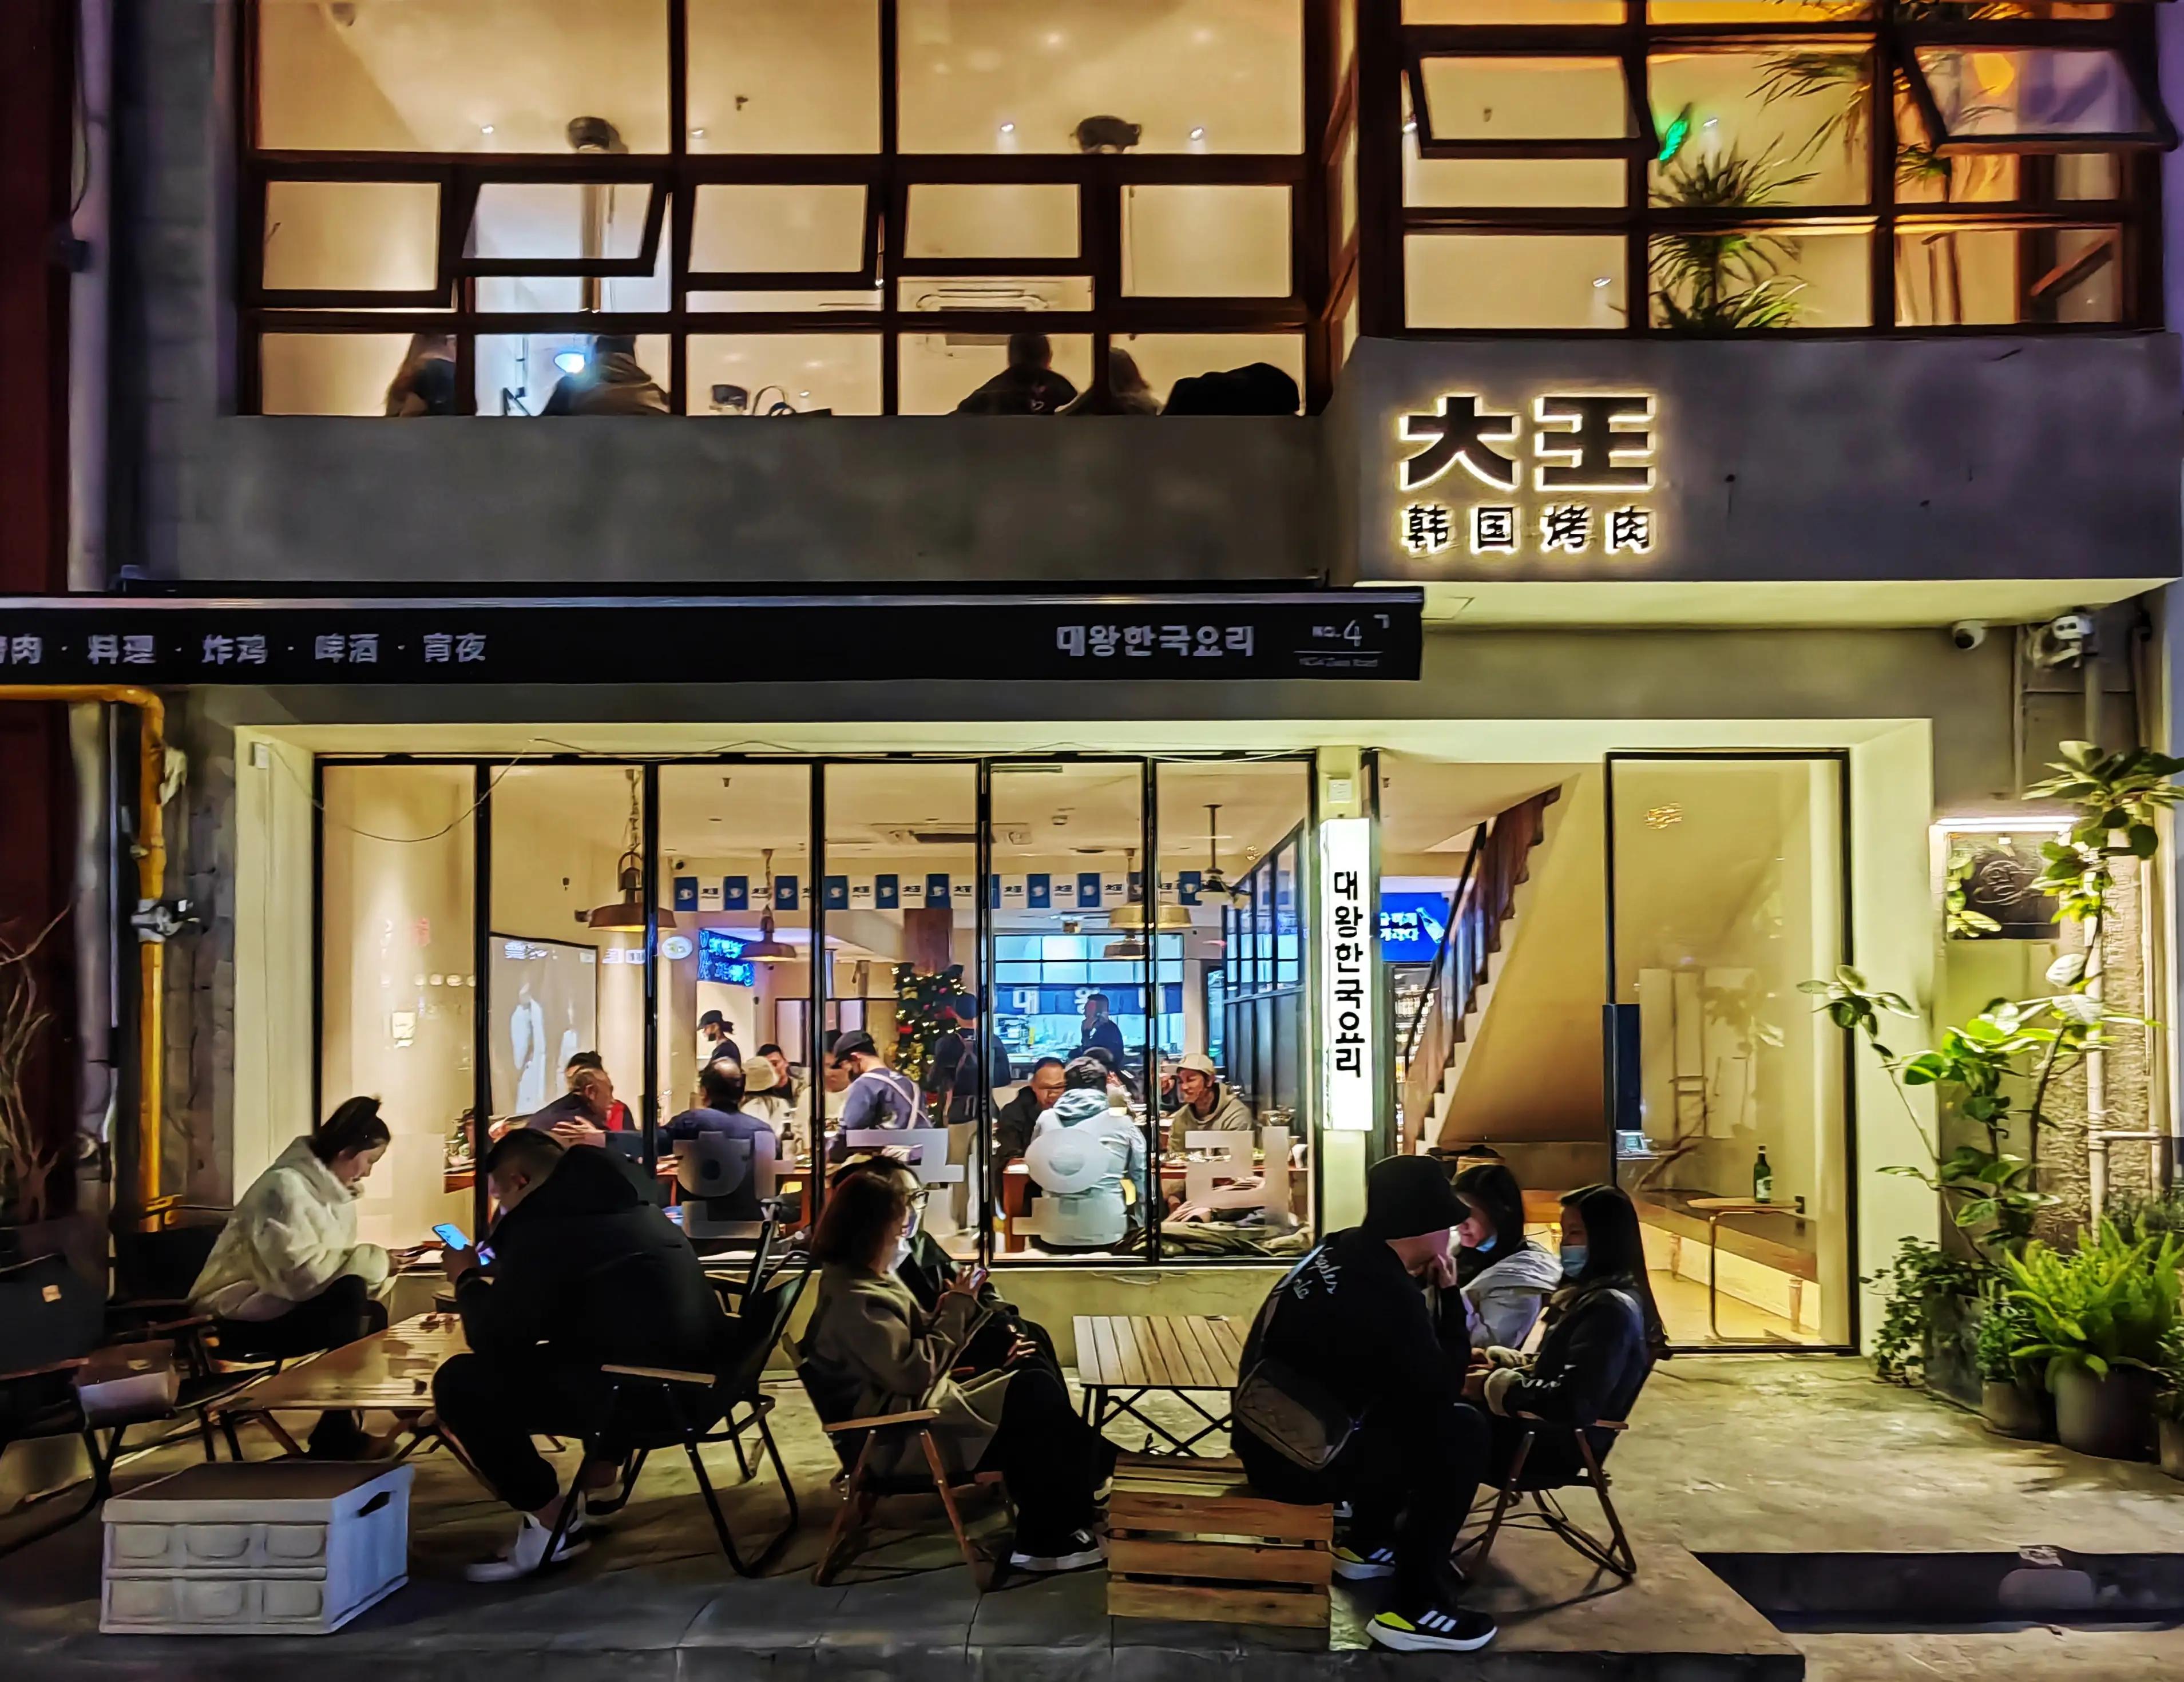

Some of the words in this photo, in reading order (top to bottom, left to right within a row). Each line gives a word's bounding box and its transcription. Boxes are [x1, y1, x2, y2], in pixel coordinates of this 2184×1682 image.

[1403, 394, 1652, 490] 大王
[1405, 505, 1651, 552] 韩国烤肉
[0, 636, 41, 664] 肉
[316, 634, 378, 663] 啤酒
[424, 633, 486, 662] 宵夜
[1057, 626, 1252, 656] 대왕한국요리
[1334, 871, 1365, 1078] 대왕한국요리
